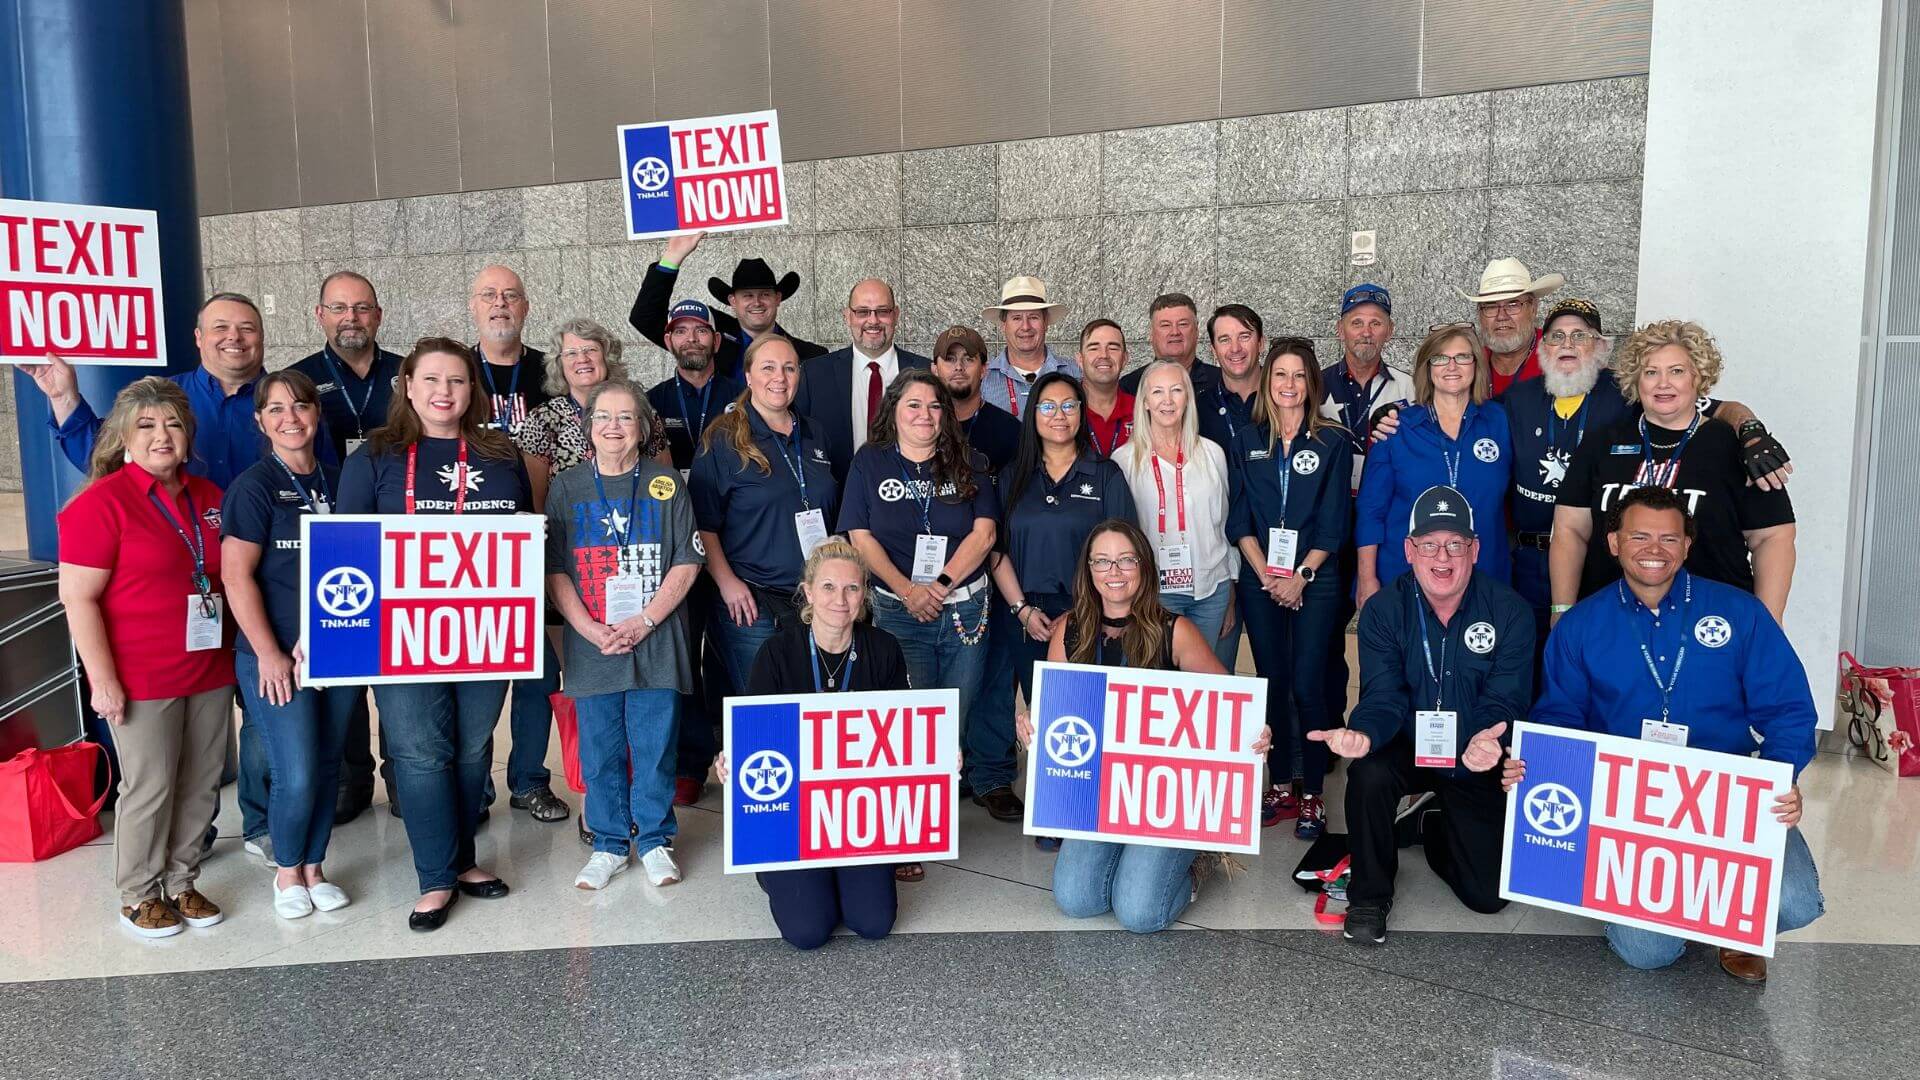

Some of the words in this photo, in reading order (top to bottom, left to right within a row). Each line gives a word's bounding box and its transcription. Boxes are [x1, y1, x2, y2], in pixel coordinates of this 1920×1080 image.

[672, 122, 769, 169] TEXIT
[636, 190, 670, 200] TNM.ME
[681, 174, 775, 223] NOW!
[0, 215, 144, 278] TEXIT
[8, 289, 148, 350] NOW!
[682, 304, 703, 312] TEXIT
[414, 500, 516, 511] NDEPNDENCE
[385, 532, 532, 588] TEXIT
[320, 618, 370, 628] TNM.ME
[391, 606, 526, 667] NOW!
[803, 706, 946, 770] TEXIT
[1108, 683, 1253, 752] TEXIT
[1046, 767, 1092, 780] TNM.ME
[1108, 762, 1244, 834] NOW!
[1599, 752, 1774, 843] TEXIT
[742, 802, 790, 814] TNM.ME
[810, 783, 941, 850] NOW!
[1524, 833, 1576, 851] TNM.ME
[1595, 836, 1759, 932] NOW!
